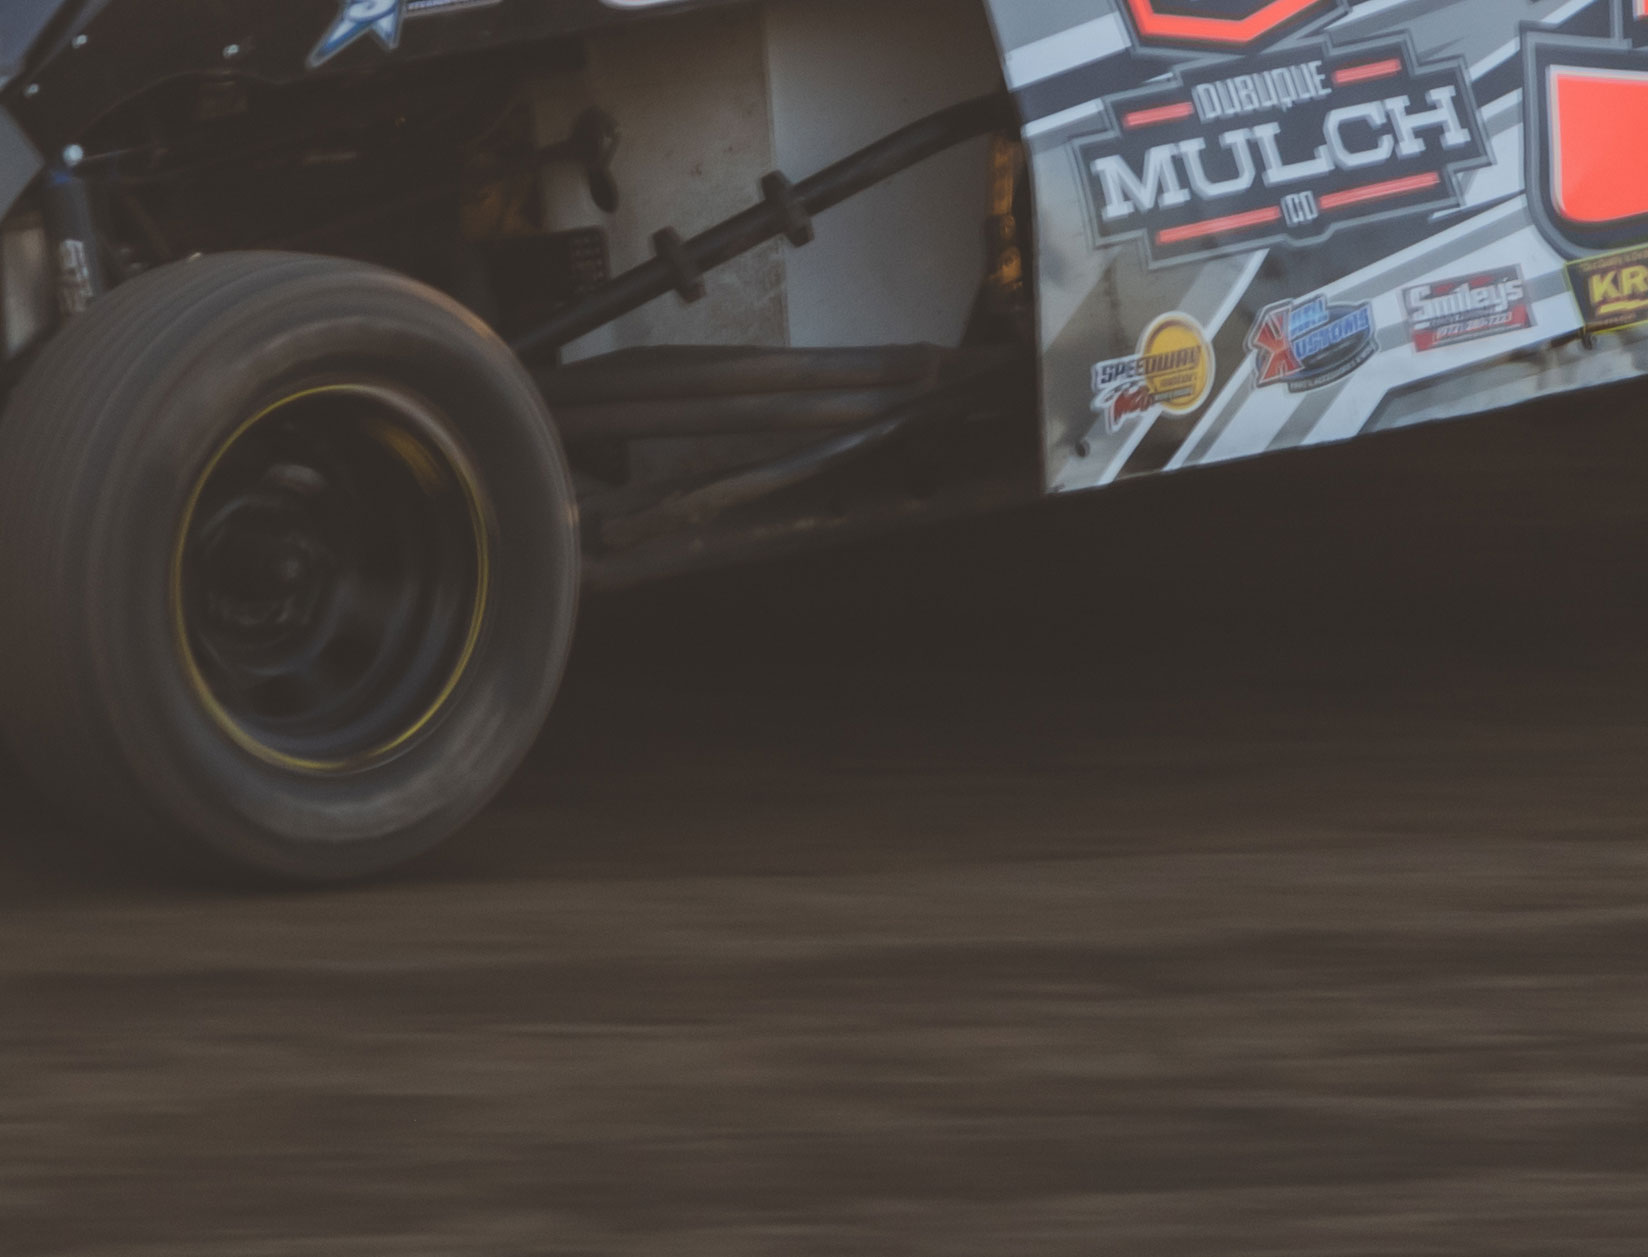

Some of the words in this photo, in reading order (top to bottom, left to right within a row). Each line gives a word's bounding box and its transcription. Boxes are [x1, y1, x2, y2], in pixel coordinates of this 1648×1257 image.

[1192, 59, 1332, 124] DUBUQUE
[1091, 86, 1471, 221] MULCH
[1280, 190, 1318, 226] CO
[1410, 276, 1525, 322] Smiley's
[1100, 344, 1201, 384] SPEEDWAY
